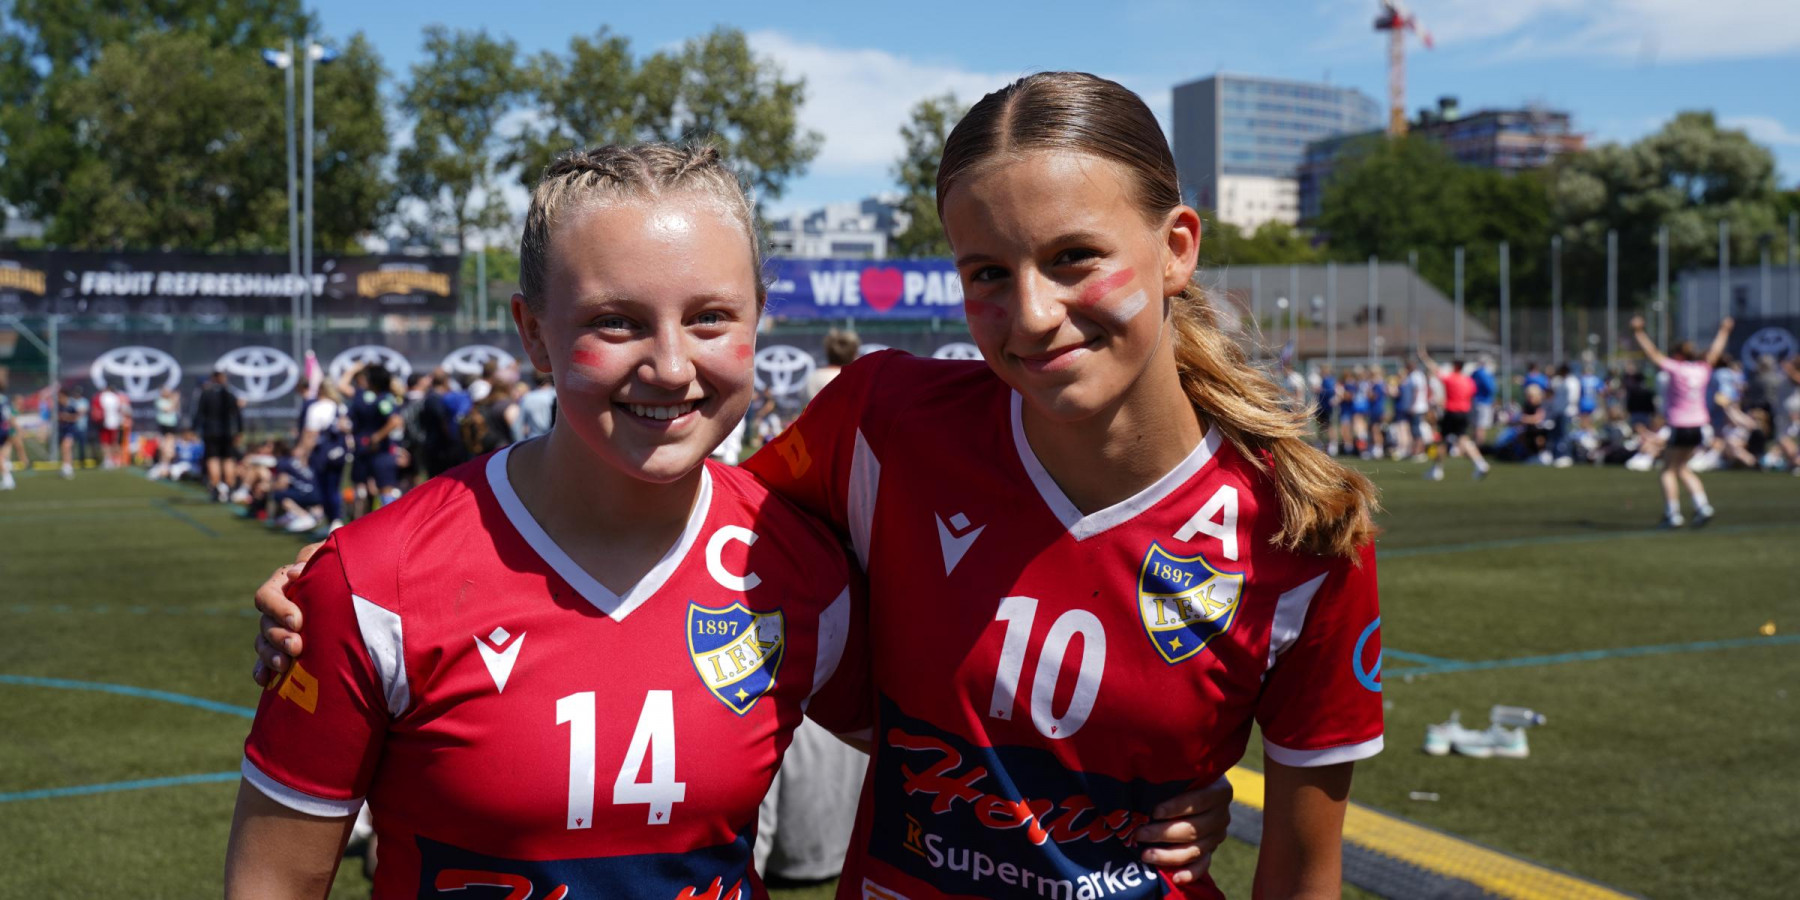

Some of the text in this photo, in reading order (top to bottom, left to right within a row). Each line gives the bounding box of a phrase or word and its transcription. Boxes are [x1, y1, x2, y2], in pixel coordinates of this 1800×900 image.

[80, 271, 327, 297] FRUIT REFRESHMENT
[810, 271, 860, 306] WE
[1173, 484, 1239, 562] A
[705, 525, 763, 592] C
[1151, 561, 1194, 587] 1897
[696, 619, 738, 636] 1897
[989, 596, 1106, 739] 10
[556, 690, 686, 830] 14
